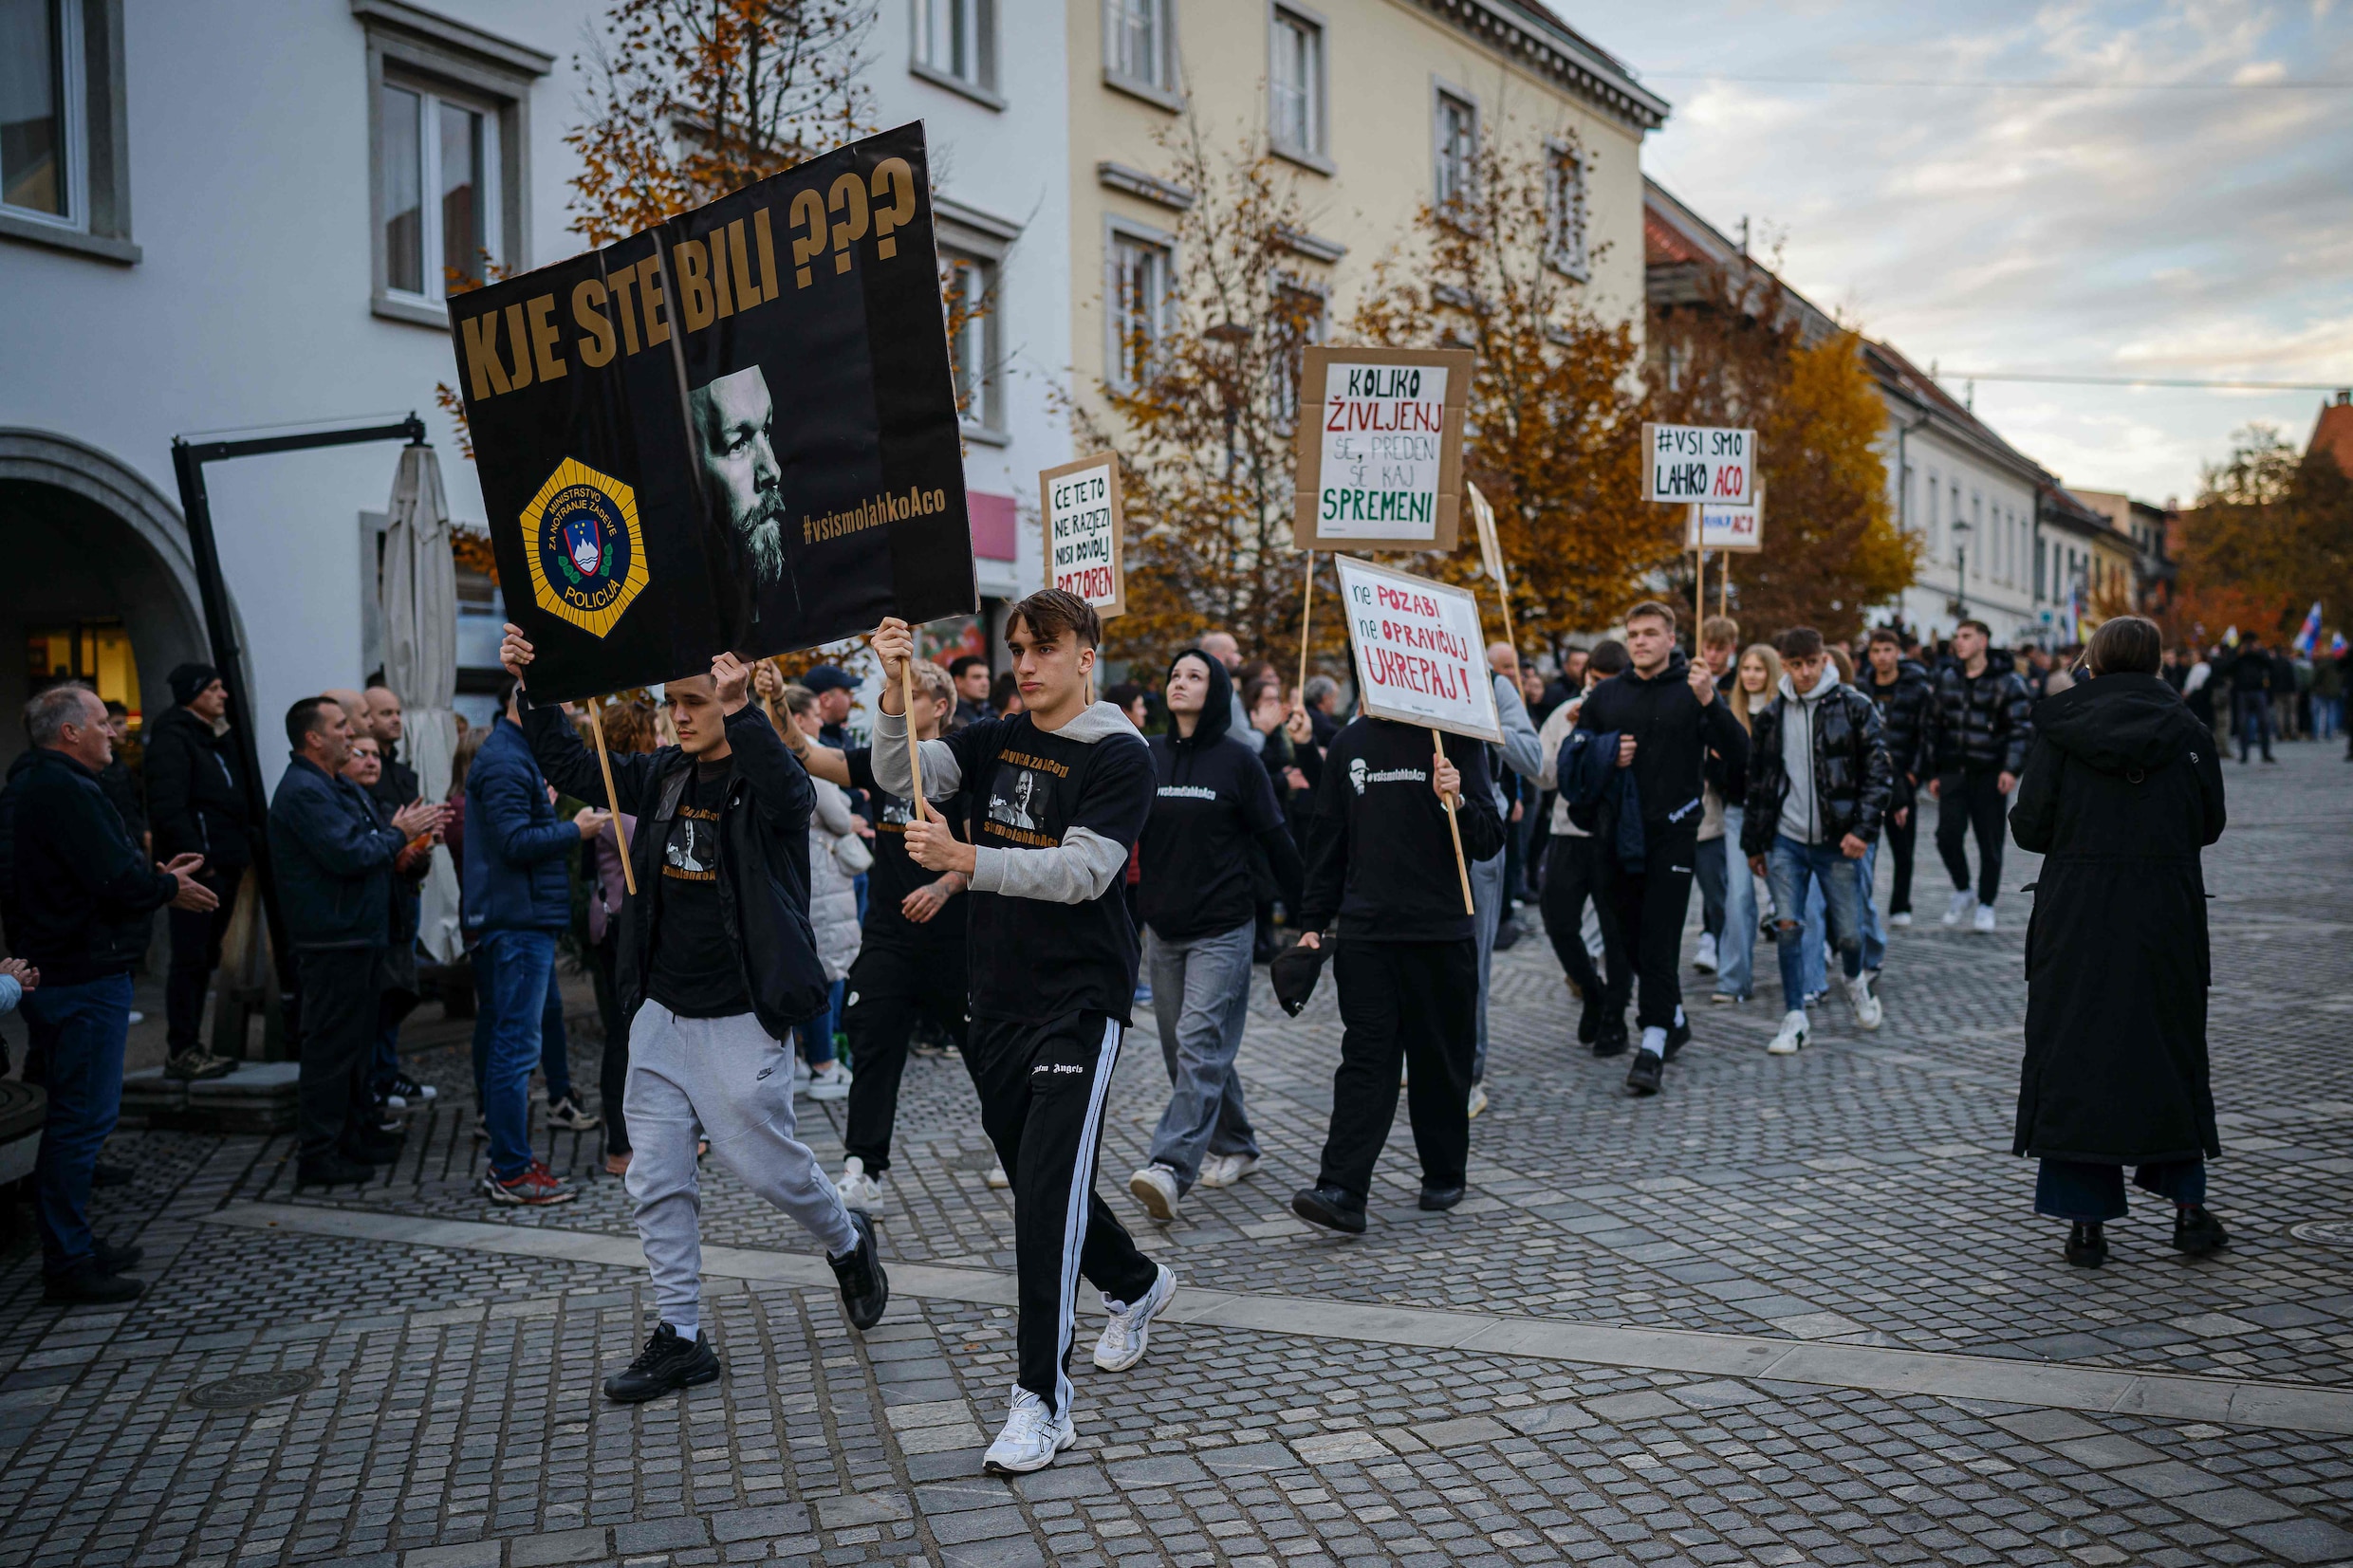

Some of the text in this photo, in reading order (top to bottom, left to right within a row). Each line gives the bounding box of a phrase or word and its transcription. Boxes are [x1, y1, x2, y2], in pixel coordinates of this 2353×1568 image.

[462, 157, 916, 400] KJE STE BILI ???
[1348, 369, 1420, 398] KOLIKO
[1326, 395, 1443, 434] ŽIVLJENJ
[1371, 435, 1436, 461] PREDEN
[1657, 429, 1743, 456] #VSI SMO
[1349, 465, 1415, 488] SE KAJ
[1657, 463, 1743, 497] LAHKO ACO
[548, 488, 602, 515] MINISTRSTVO
[1055, 477, 1104, 510] ČE TE TO
[1322, 488, 1433, 524] SPREMENI
[548, 499, 618, 551] ZA NOTRANJE ZADEVE
[803, 486, 946, 544] #vsismolahkoAco
[1054, 507, 1110, 541] NE RAZJEZI
[1055, 536, 1109, 567] NISI DOVOLJ
[565, 579, 621, 608] POLICIJA
[1352, 584, 1440, 618] ne POZABI
[1359, 618, 1469, 662] ne OPRAVIČUJ
[1052, 1063, 1084, 1074] Angels
